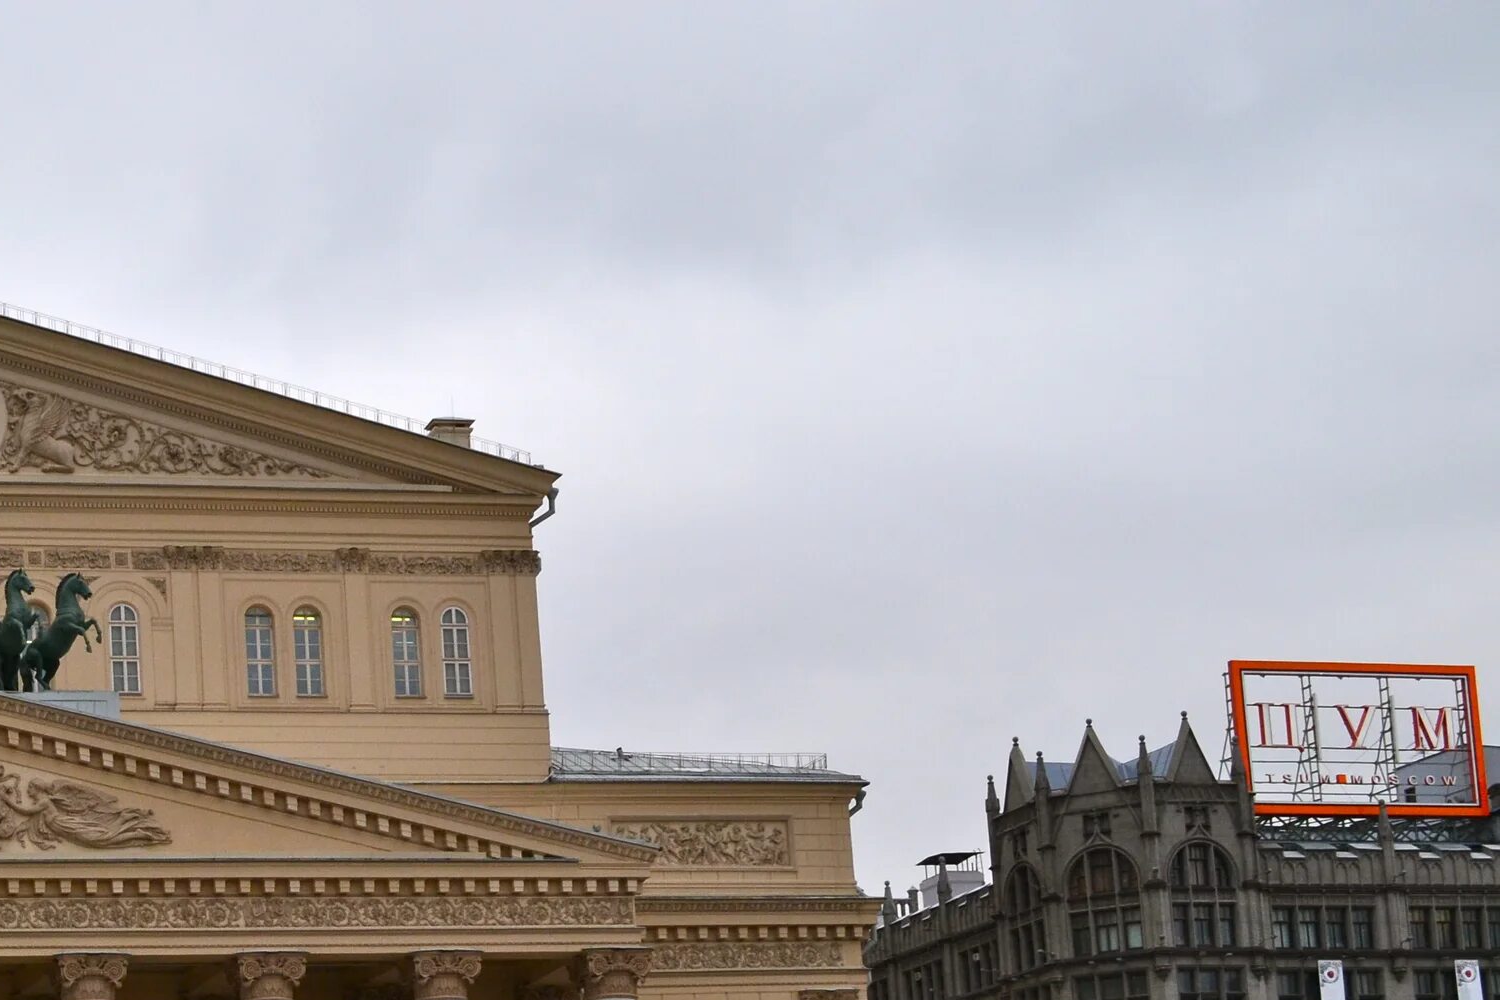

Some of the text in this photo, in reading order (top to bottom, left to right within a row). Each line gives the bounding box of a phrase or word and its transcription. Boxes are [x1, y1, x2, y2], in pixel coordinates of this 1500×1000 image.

[1256, 702, 1457, 753] ЦУМ
[1265, 773, 1457, 786] TSUM MOSCOW
